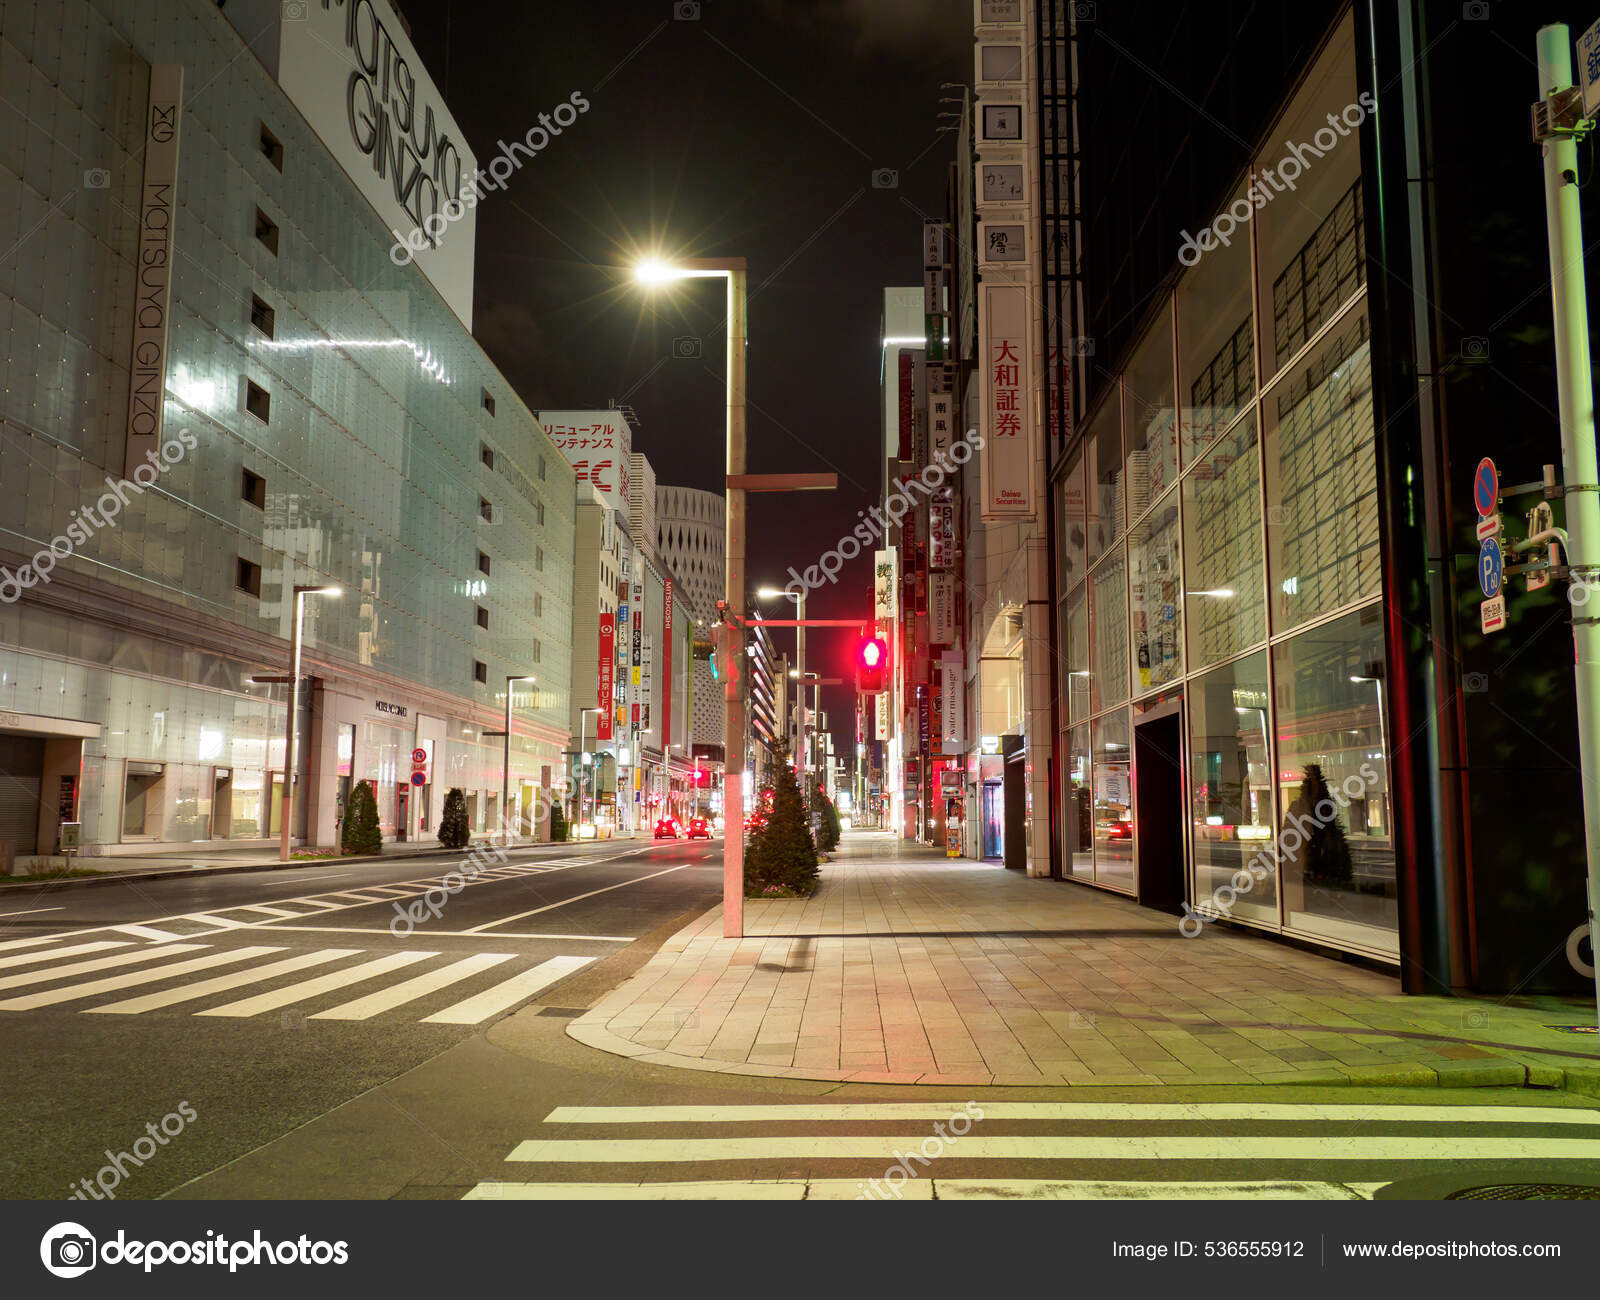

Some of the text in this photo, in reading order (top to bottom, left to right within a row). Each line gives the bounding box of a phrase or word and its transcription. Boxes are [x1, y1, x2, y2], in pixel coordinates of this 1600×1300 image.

[994, 340, 1021, 437] 大和証券
[544, 424, 615, 435] リニューアル
[1001, 490, 1021, 498] Daiwa
[1483, 555, 1493, 592] P
